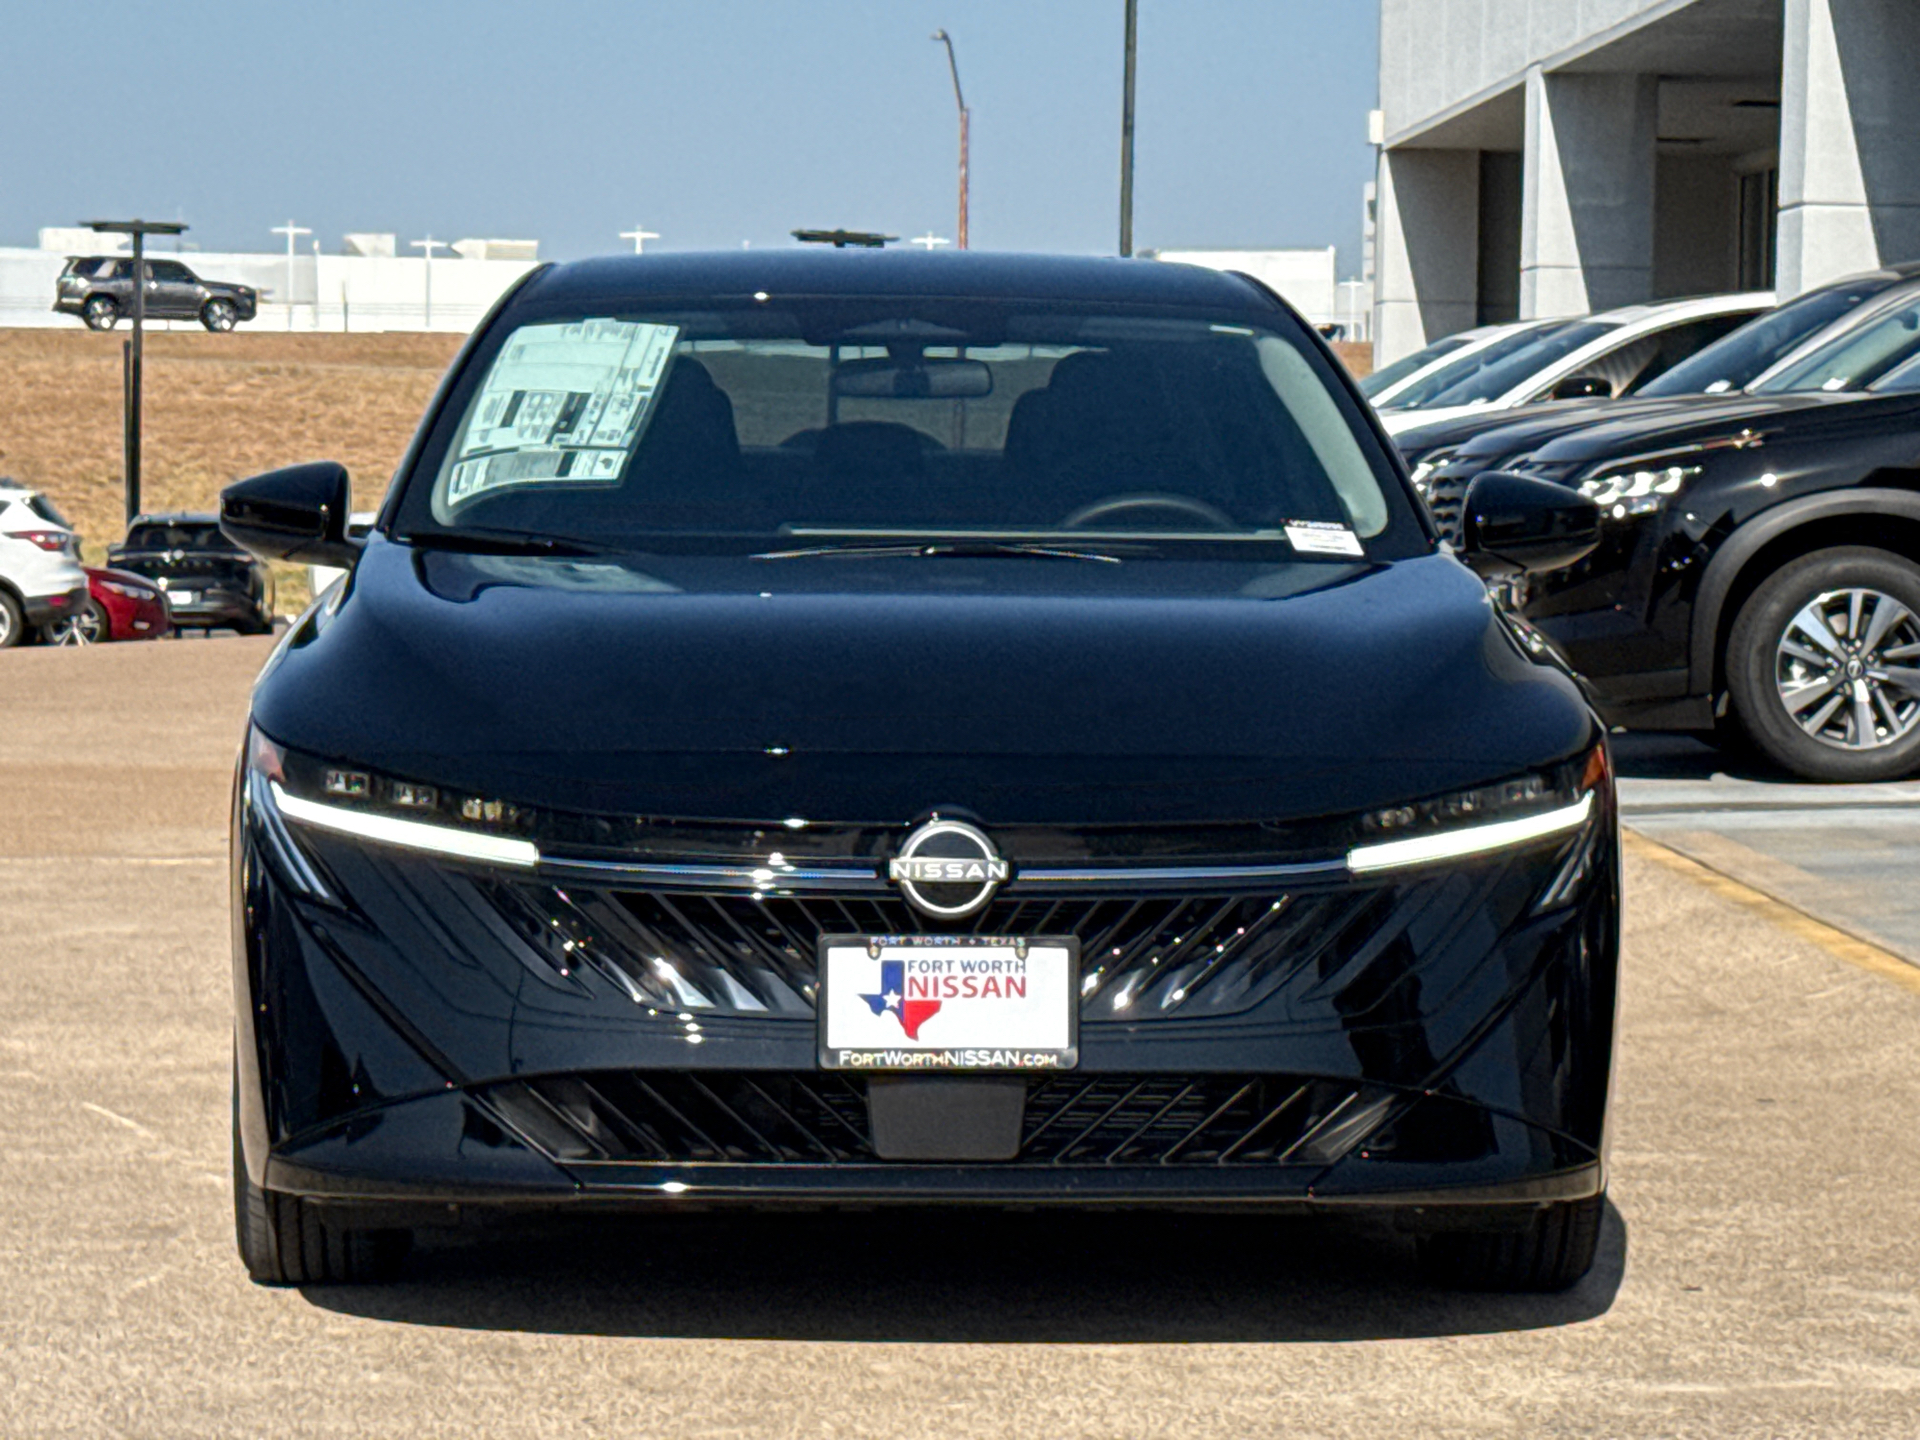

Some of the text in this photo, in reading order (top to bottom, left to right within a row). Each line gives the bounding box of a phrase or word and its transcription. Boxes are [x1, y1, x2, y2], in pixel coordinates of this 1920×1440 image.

[892, 863, 1006, 879] NISSAN
[870, 936, 1026, 947] FORT WORTH TEXAS
[907, 960, 1027, 974] FORT WORTH
[908, 976, 1026, 998] NISSAN
